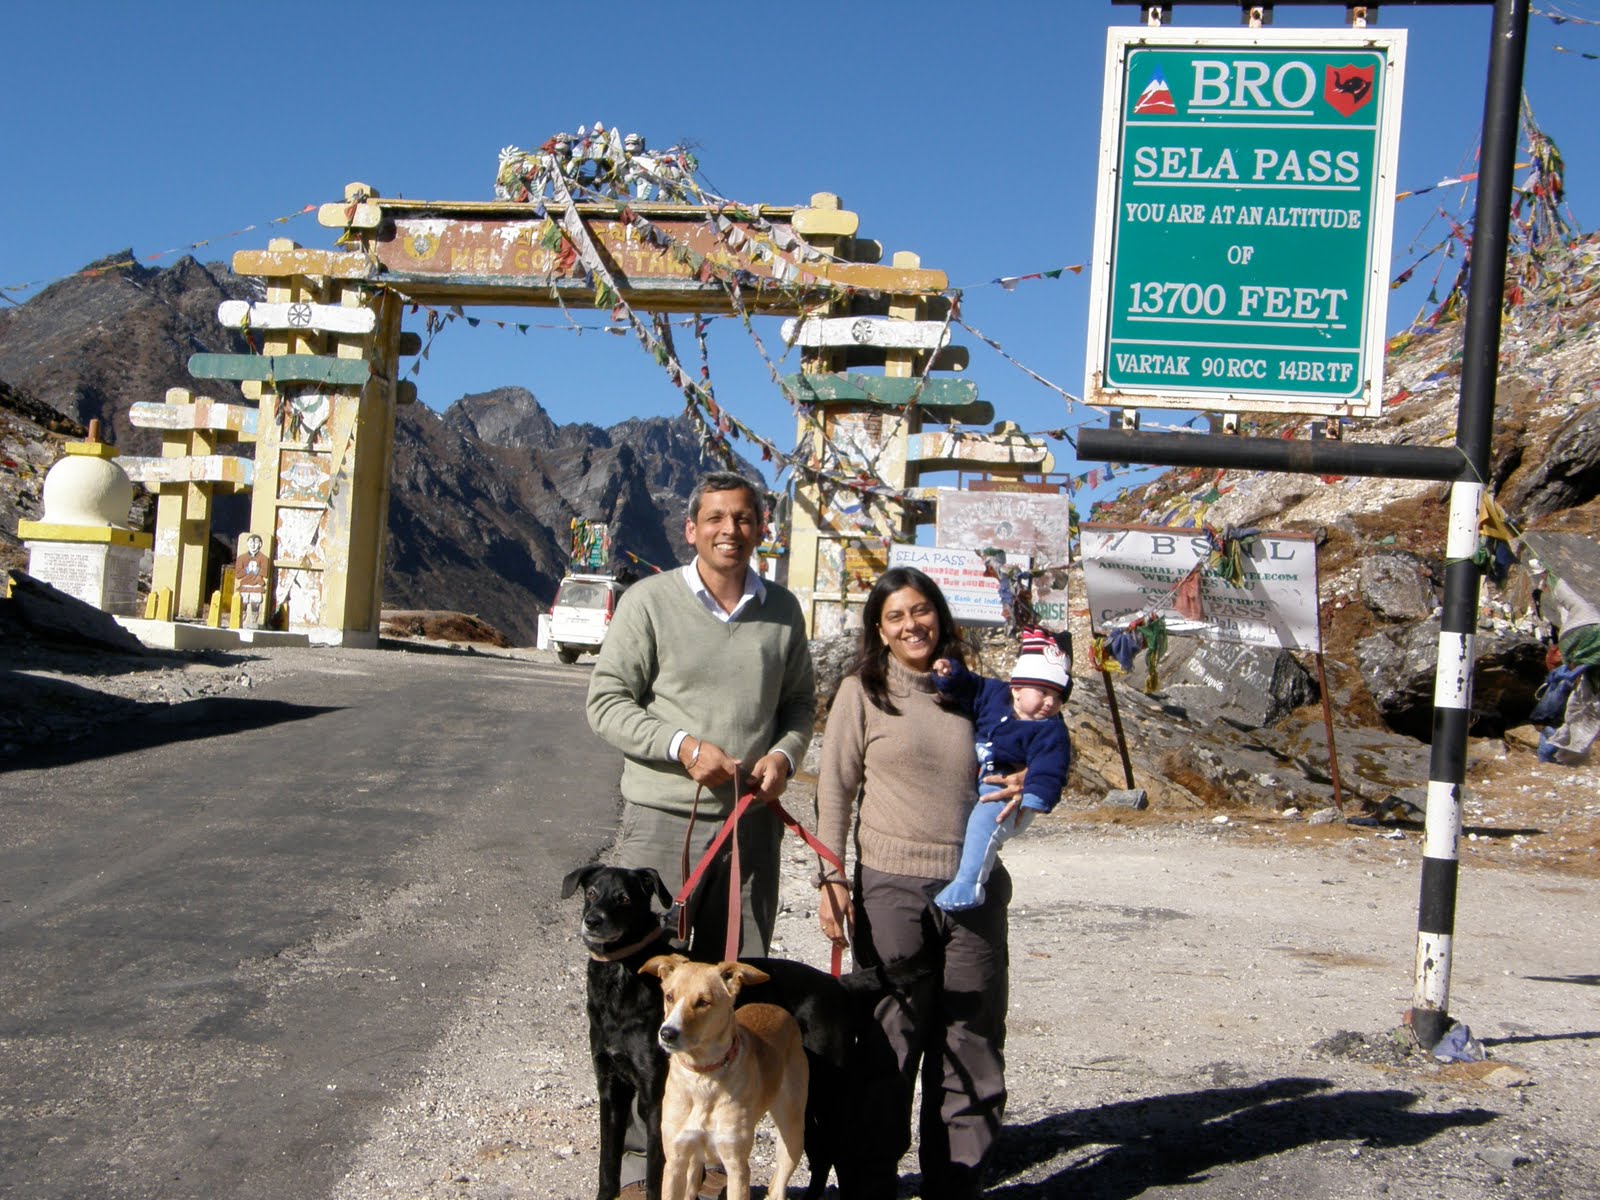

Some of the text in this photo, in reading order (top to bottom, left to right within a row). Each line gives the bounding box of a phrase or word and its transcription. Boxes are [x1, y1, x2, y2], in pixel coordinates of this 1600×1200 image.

[1188, 60, 1316, 108] BRO
[1134, 146, 1360, 183] SELA PASS
[1126, 202, 1361, 229] YOU ARE AT AN ALTITUDE
[1227, 245, 1254, 265] OF
[1128, 282, 1348, 320] 13700 FEET
[1116, 353, 1190, 376] VARTAK
[1201, 357, 1225, 378] 90
[1227, 359, 1267, 379] RCC
[896, 551, 930, 564] SELA
[933, 553, 966, 567] PASS
[1210, 603, 1266, 618] PASS
